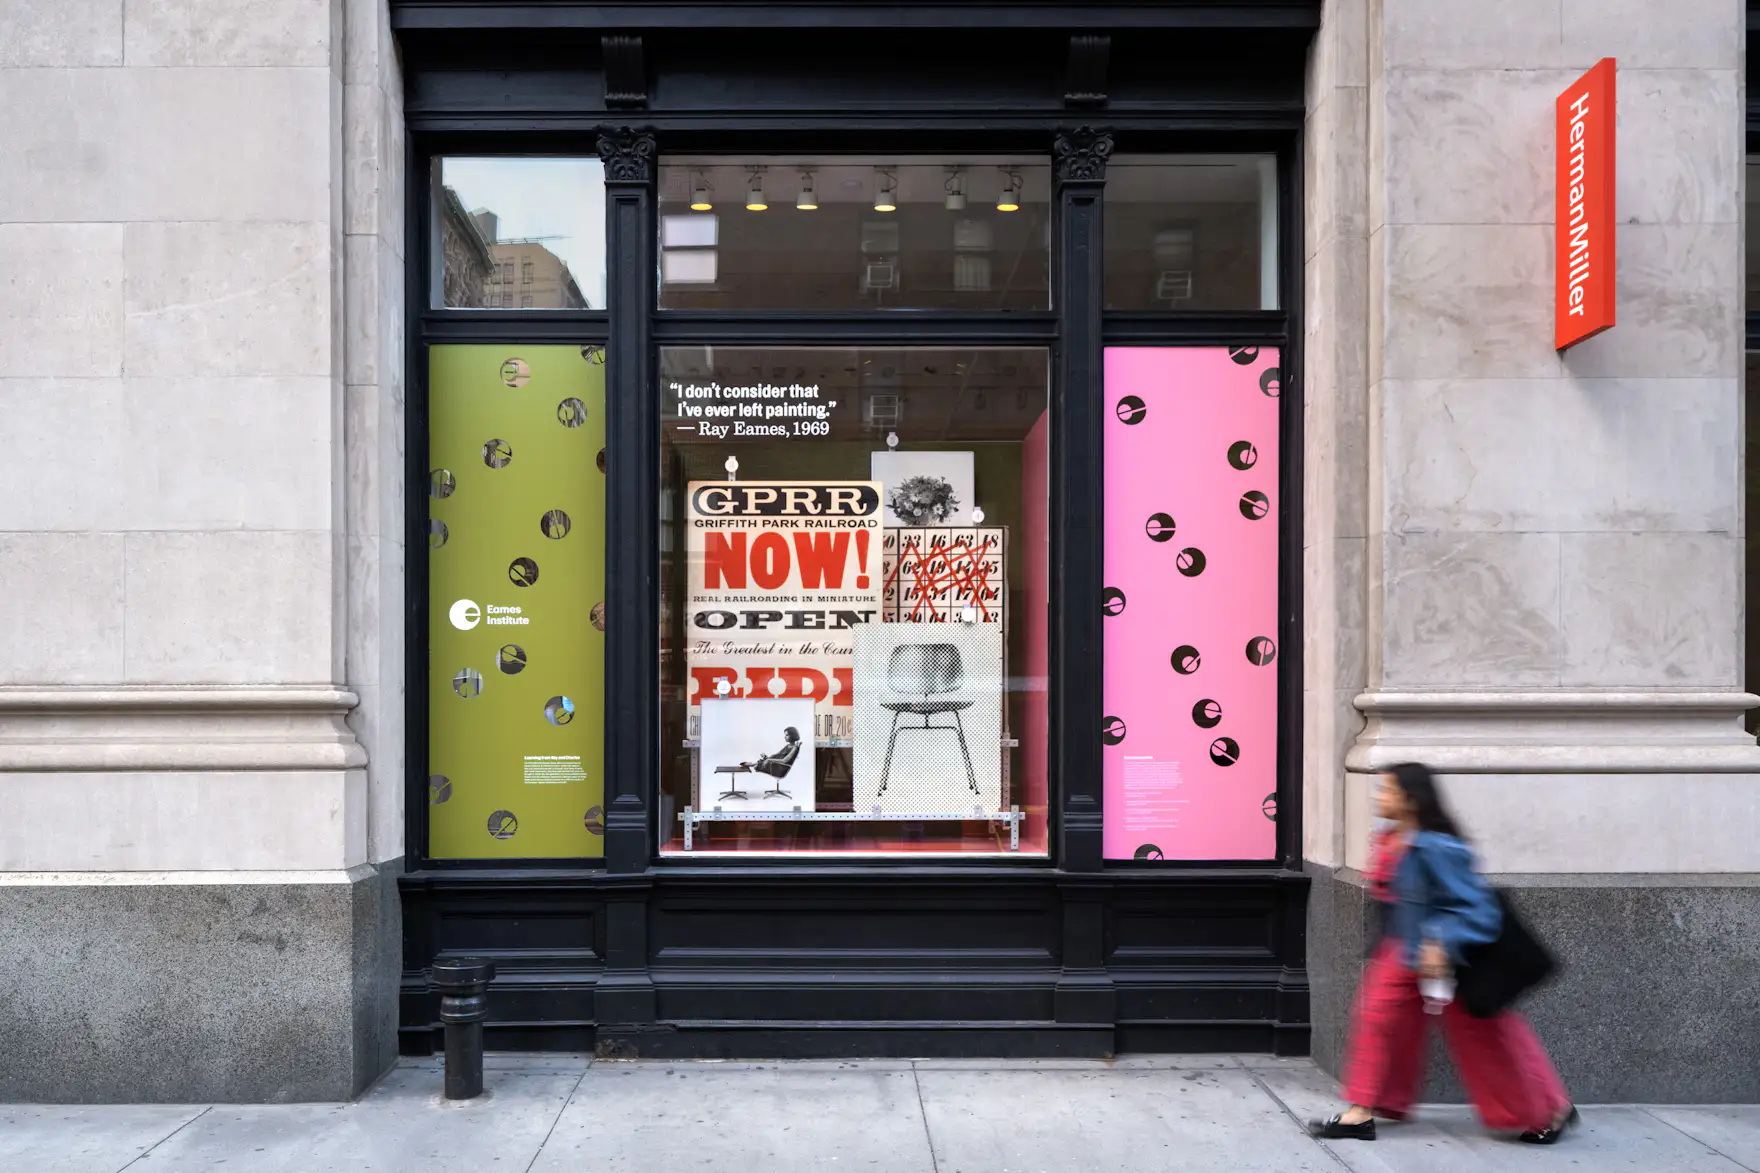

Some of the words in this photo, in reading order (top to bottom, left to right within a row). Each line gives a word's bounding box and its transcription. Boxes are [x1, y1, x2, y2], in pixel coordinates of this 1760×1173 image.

[685, 382, 721, 398] don’t
[723, 384, 787, 398] consider
[789, 384, 819, 398] that
[677, 401, 702, 417] I’ve
[705, 405, 737, 417] ever
[739, 402, 763, 417] left
[765, 401, 837, 419] painting.”
[699, 421, 729, 439] Ray
[733, 421, 790, 438] Eames,
[793, 421, 829, 436] 1969
[698, 487, 868, 515] GPRR
[694, 519, 757, 528] GRIFFITH
[762, 519, 800, 528] PARK
[804, 519, 878, 528] RAILROAD
[883, 535, 895, 548] 0
[704, 529, 870, 590] NOW!
[486, 604, 522, 614] Eames
[486, 616, 530, 625] Institute
[693, 610, 877, 630] OPEN
[692, 640, 716, 655] The
[721, 641, 775, 655] Greatest
[778, 644, 792, 655] in
[798, 641, 818, 655] the
[822, 641, 853, 655] Coun
